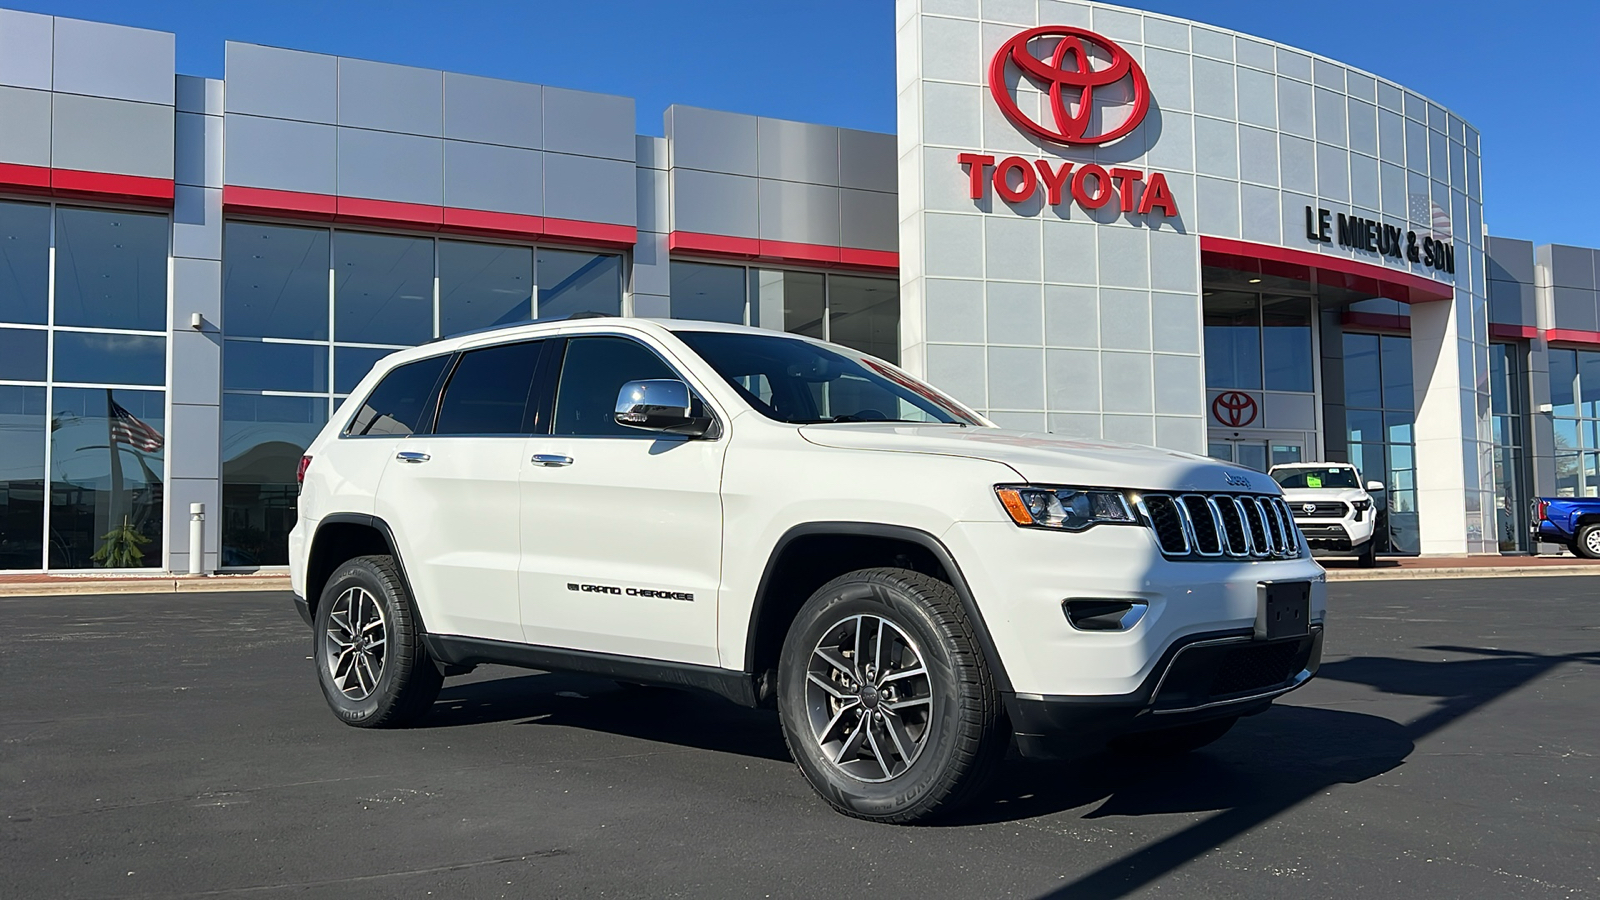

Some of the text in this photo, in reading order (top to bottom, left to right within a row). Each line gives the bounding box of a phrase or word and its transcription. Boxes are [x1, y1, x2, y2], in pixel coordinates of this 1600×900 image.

[957, 153, 1178, 217] TOYOTA
[1305, 206, 1455, 274] LE MIEUX & SON
[581, 584, 695, 601] GRAND CHEROKEE
